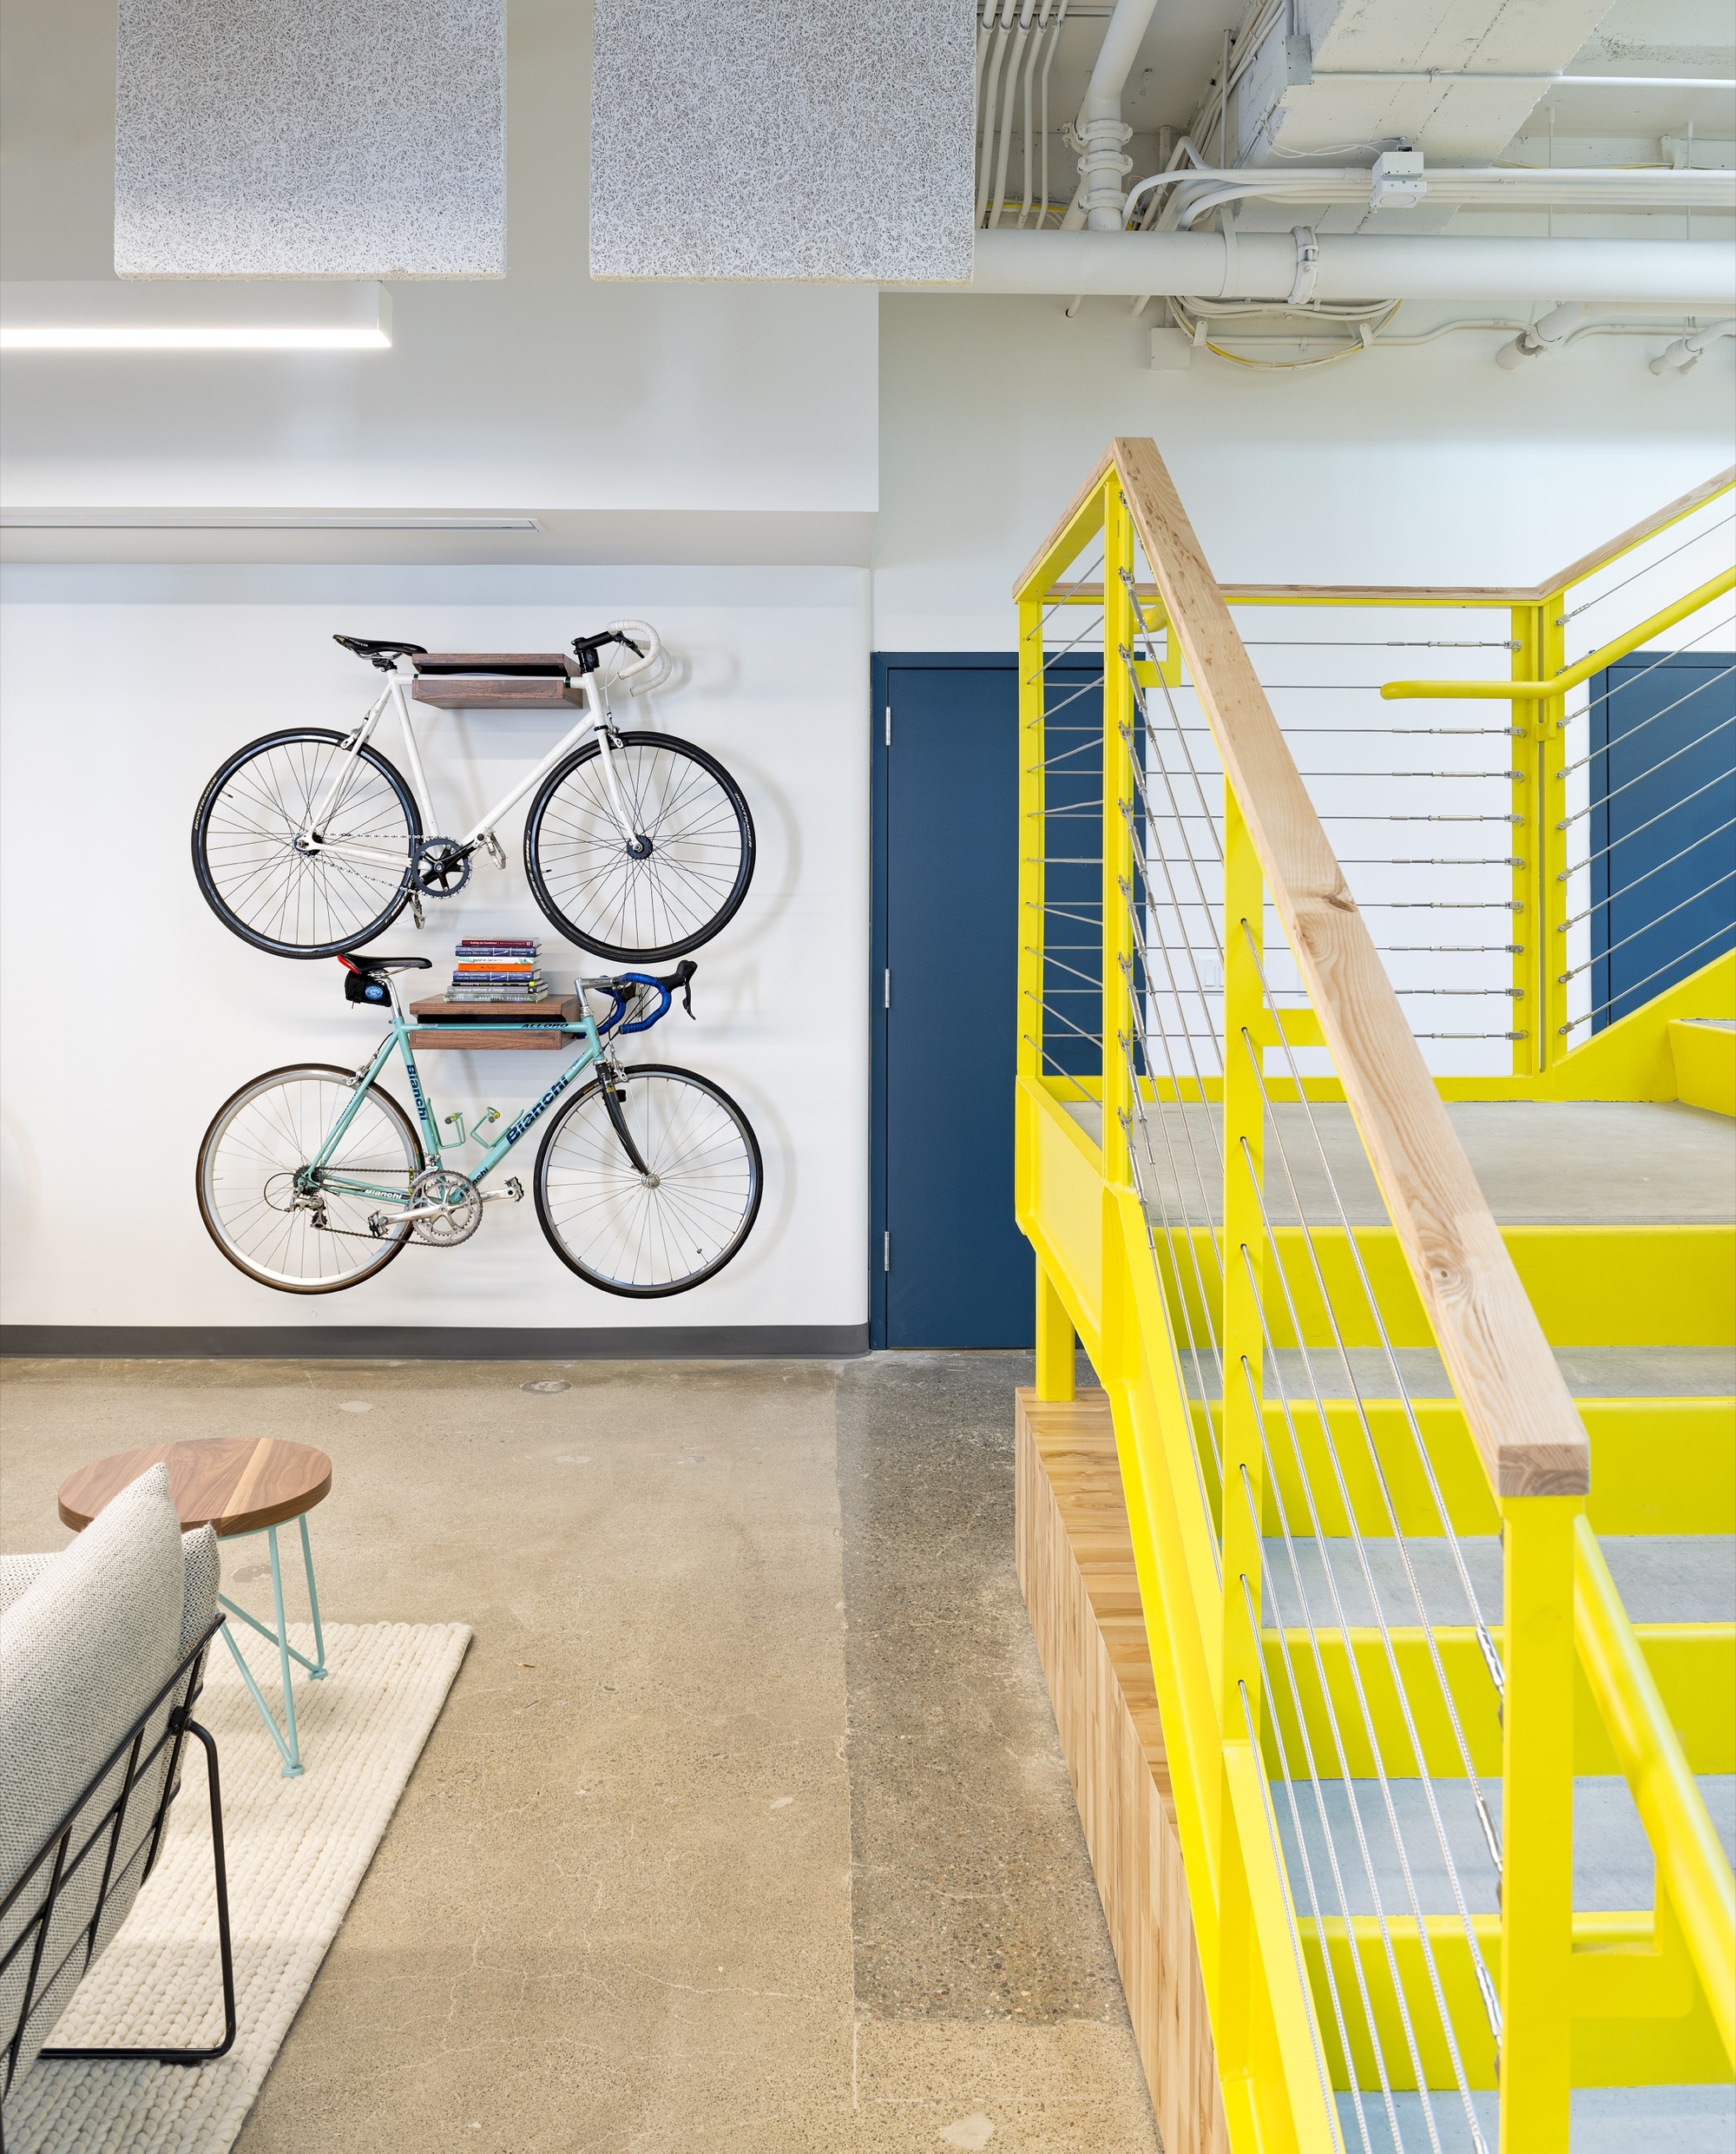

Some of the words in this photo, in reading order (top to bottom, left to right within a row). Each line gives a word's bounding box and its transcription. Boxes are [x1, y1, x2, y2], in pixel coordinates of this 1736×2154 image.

[348, 638, 368, 648] marco
[194, 776, 218, 831] BONTRAGER
[734, 792, 753, 848] BONTRAGER
[406, 1064, 429, 1121] Bianchi
[505, 1074, 569, 1144] Bianchi
[365, 1189, 403, 1200] Bianchi
